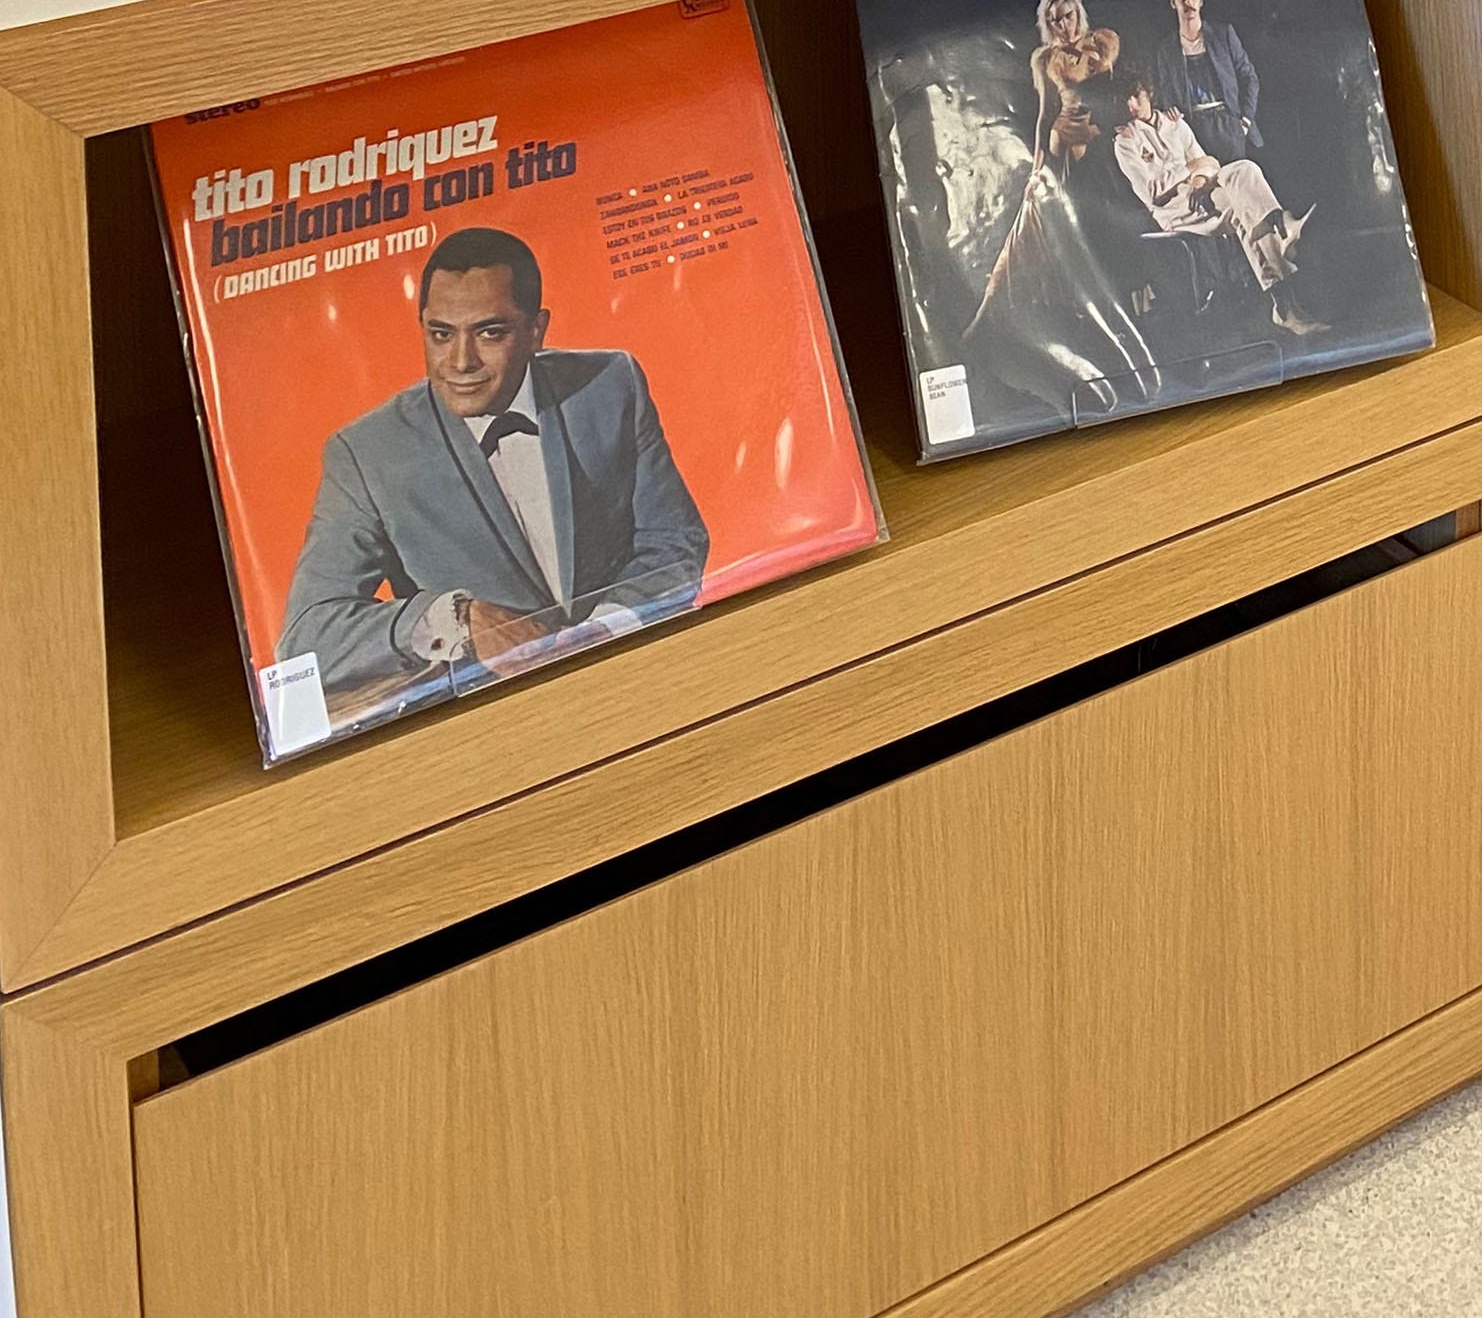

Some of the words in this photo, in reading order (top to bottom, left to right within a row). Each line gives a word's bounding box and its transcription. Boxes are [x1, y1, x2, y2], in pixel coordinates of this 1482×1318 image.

[192, 169, 274, 222] tito
[211, 180, 409, 266] bailando
[423, 162, 494, 211] con
[505, 140, 576, 189] tito
[214, 254, 316, 303] (DANCING
[324, 239, 379, 272] WITH
[386, 221, 438, 254] TITO)
[267, 670, 277, 680] LP
